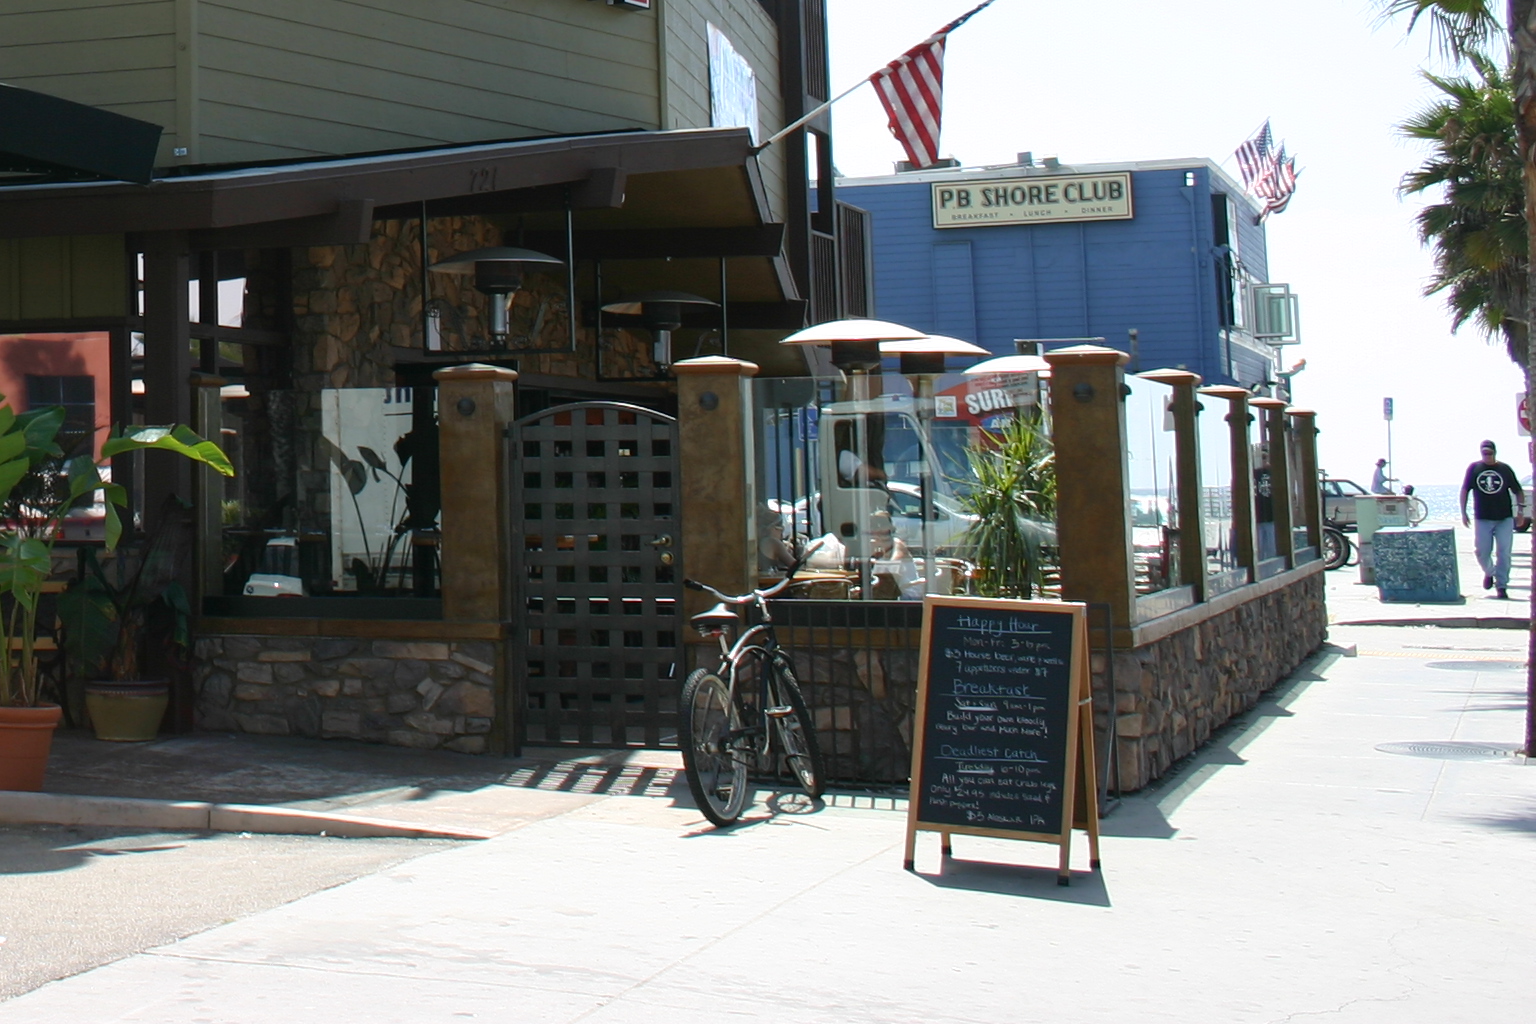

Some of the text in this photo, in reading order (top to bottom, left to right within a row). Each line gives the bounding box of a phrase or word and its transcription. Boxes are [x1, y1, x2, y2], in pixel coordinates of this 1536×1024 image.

[981, 184, 1060, 207] SHORE
[1063, 180, 1124, 203] CLUB
[951, 212, 999, 221] BREAKFAST
[1023, 209, 1051, 217] LUNCH
[957, 615, 1040, 637] Happy Hour
[953, 678, 1031, 696] Breakfast
[946, 710, 972, 721] Build
[940, 744, 999, 757] Deadliest
[941, 772, 955, 784] All
[958, 776, 976, 788] you
[1029, 814, 1046, 825] IPA
